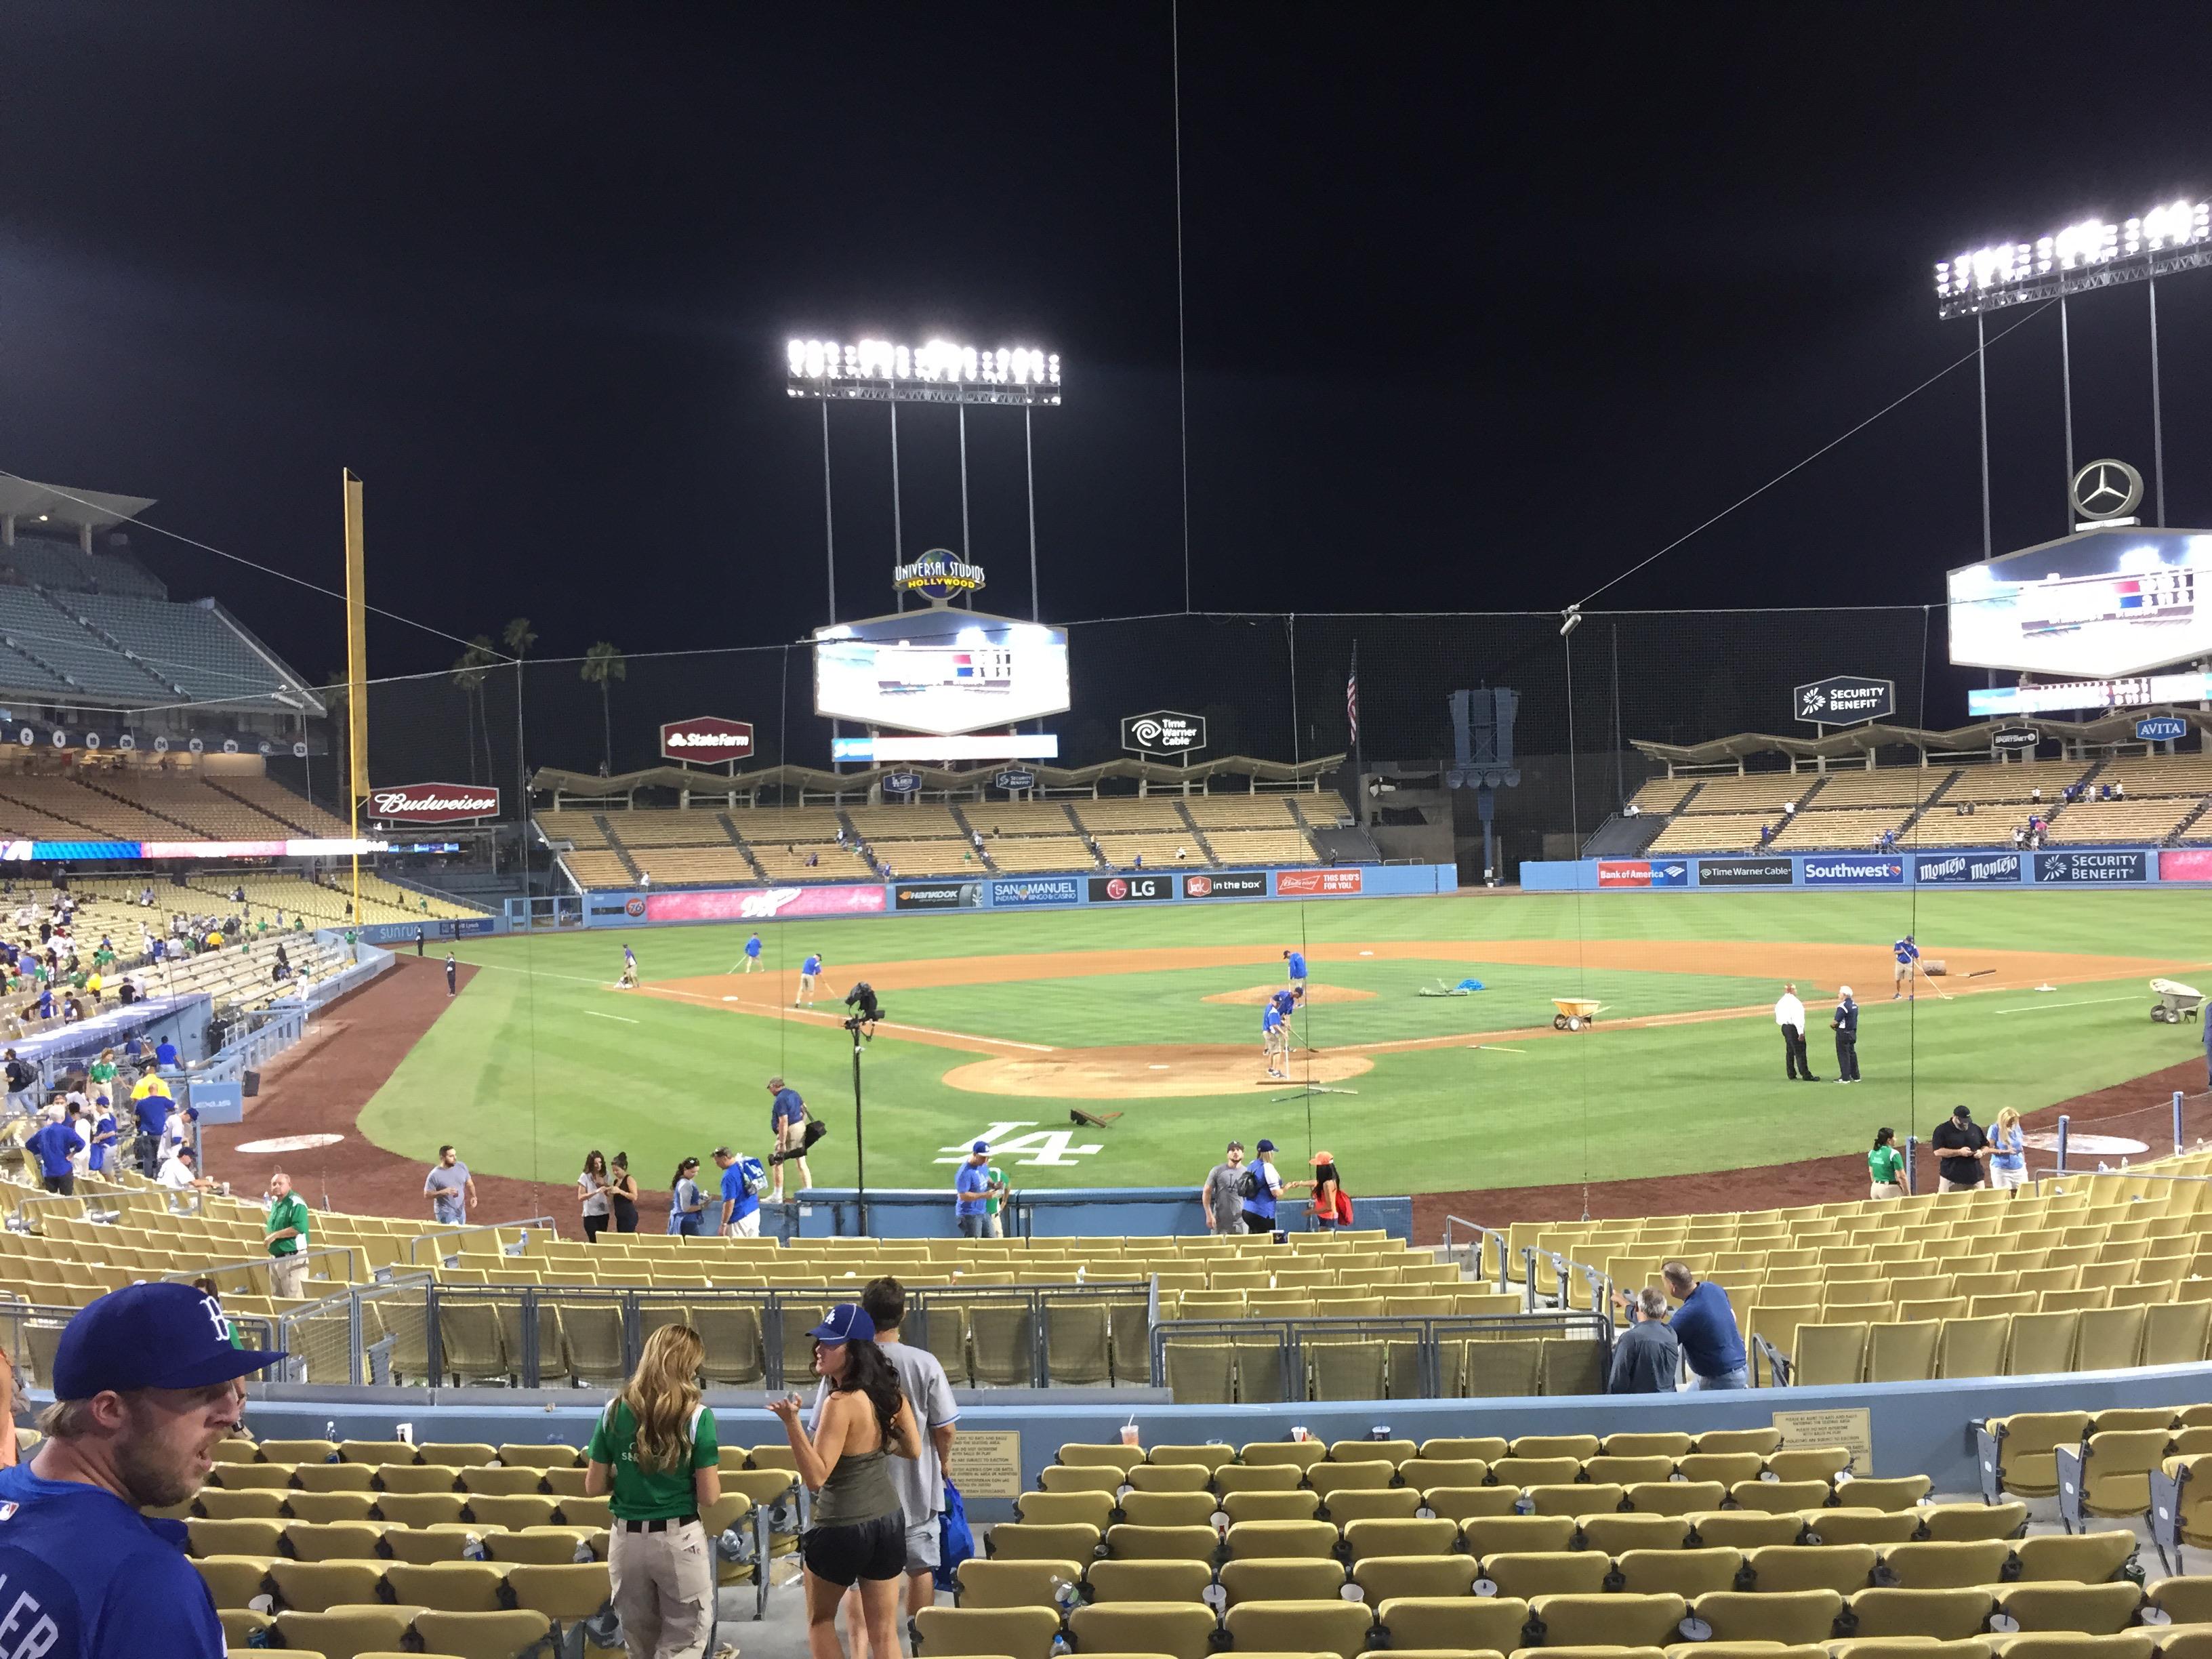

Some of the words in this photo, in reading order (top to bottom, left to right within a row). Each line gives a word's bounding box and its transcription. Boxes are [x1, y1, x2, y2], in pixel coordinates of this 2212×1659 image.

[895, 561, 946, 581] UNIVERSAL
[949, 562, 985, 581] STUDIOS
[908, 578, 975, 588] HOLLYWOOD
[1830, 687, 1885, 699] SECURITY
[1830, 699, 1878, 711] BENEFIT
[1162, 719, 1186, 728] Time
[2140, 722, 2181, 735] AVITA
[687, 733, 719, 746] State
[719, 733, 749, 746] Farm
[1162, 729, 1197, 737] Warner
[1162, 737, 1189, 745] Cable
[375, 794, 495, 813] Budweiser
[2072, 855, 2137, 866] SECURITY
[1600, 870, 1620, 878] Bank
[1621, 870, 1631, 878] of
[1631, 870, 1664, 878] America
[1733, 867, 1763, 876] Warner
[1805, 863, 1889, 878] Southwest
[1920, 857, 1965, 881] Montejo
[1970, 855, 2018, 880] Montejo
[2072, 868, 2129, 879] BENEFIT
[995, 884, 1019, 895] SAN
[1028, 882, 1076, 894] MANUEL
[1131, 880, 1155, 897] LG
[1189, 879, 1210, 893] Jack
[1224, 881, 1240, 889] the
[629, 901, 643, 914] 76
[932, 1122, 1104, 1166] LA
